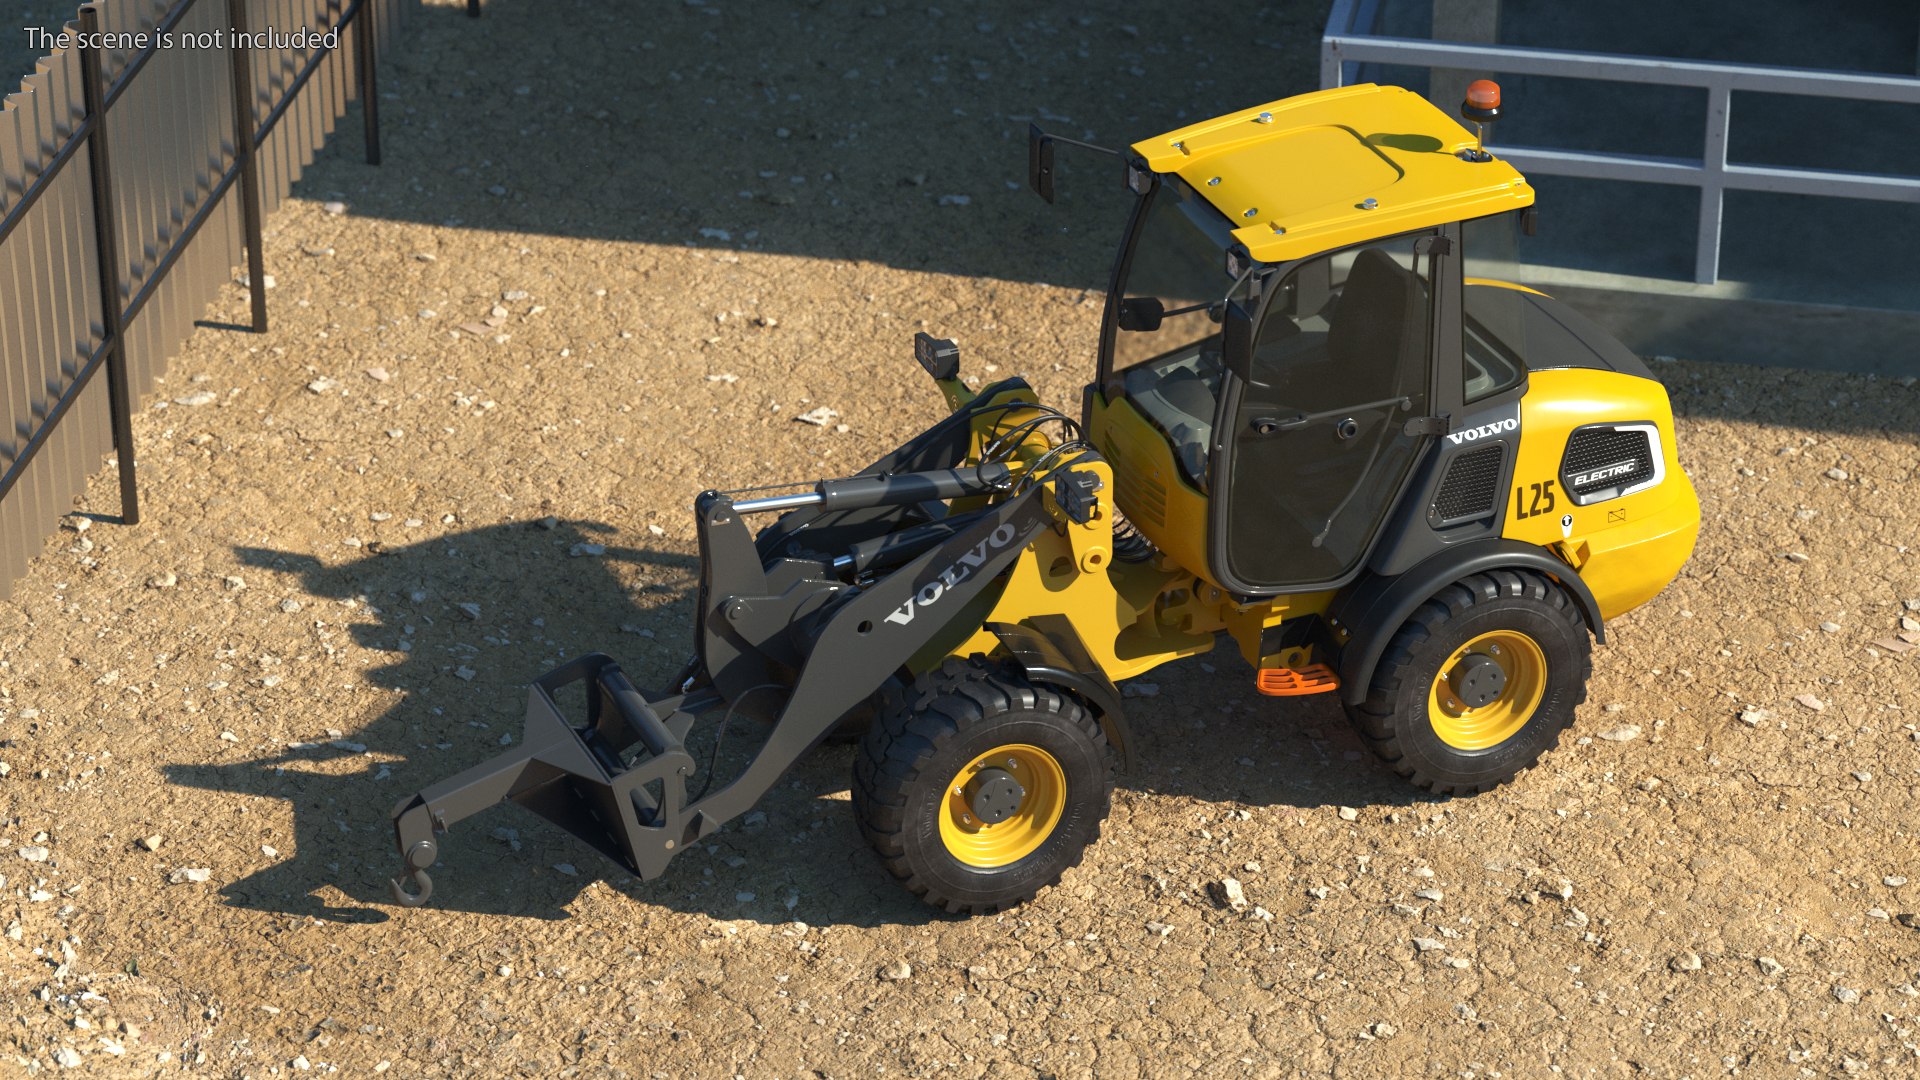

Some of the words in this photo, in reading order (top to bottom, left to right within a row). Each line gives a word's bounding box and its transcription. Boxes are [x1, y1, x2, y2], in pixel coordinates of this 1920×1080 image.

[1447, 418, 1517, 444] VOLVO
[1574, 462, 1635, 486] ELECTRIC
[1517, 480, 1554, 520] L25
[884, 523, 1015, 625] VOLVO
